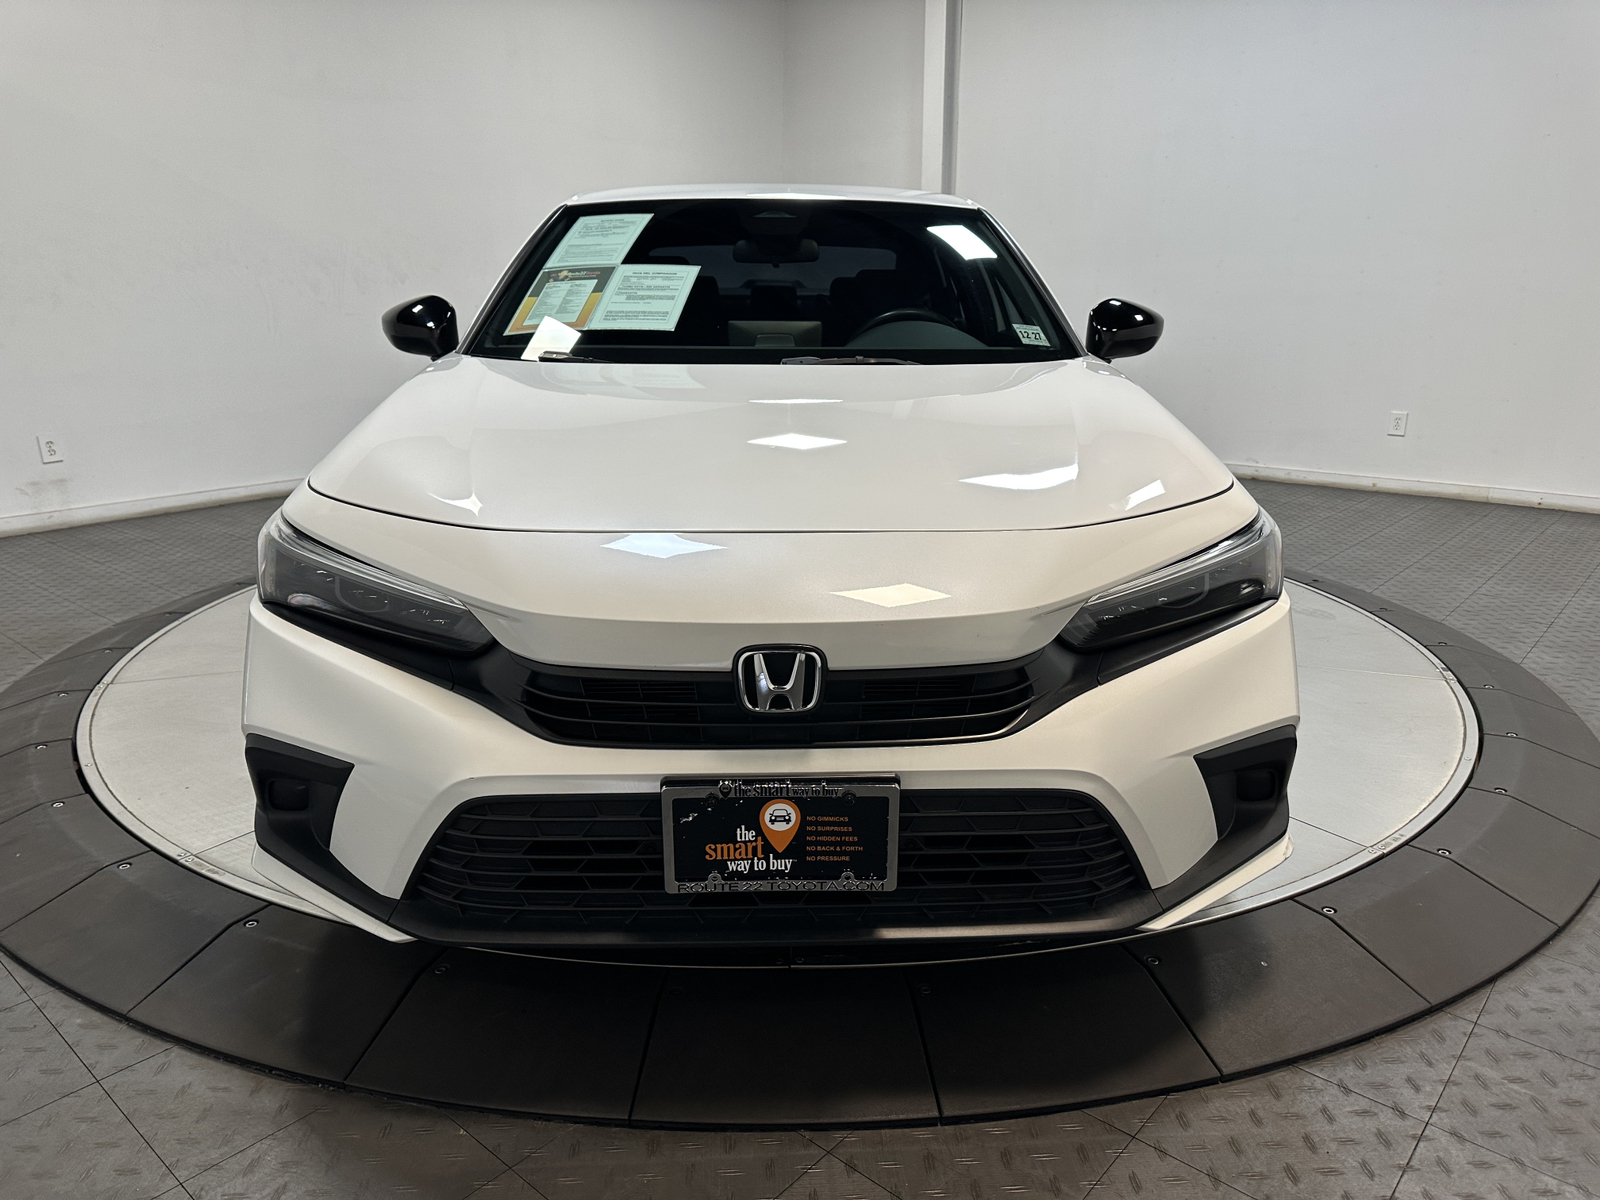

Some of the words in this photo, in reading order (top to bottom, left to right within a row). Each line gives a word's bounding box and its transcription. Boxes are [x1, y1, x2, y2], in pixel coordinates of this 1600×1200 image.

[1019, 330, 1031, 339] 12
[1032, 332, 1042, 340] 27
[736, 825, 756, 842] the
[705, 836, 764, 860] smart
[727, 860, 751, 874] way
[753, 857, 767, 871] to
